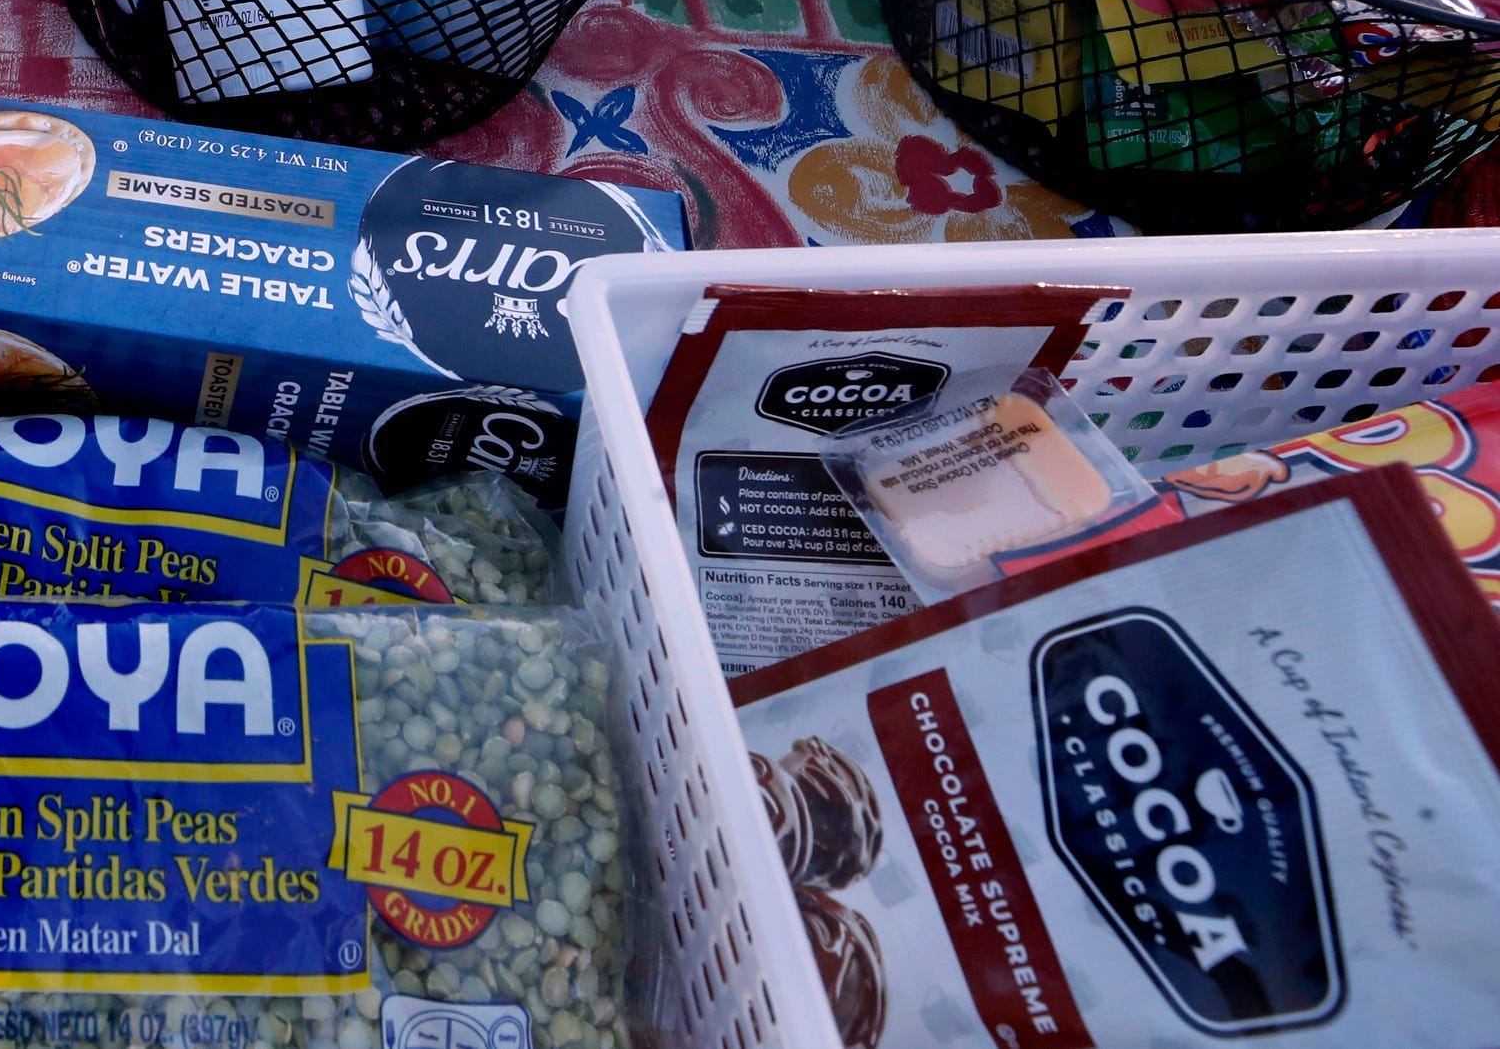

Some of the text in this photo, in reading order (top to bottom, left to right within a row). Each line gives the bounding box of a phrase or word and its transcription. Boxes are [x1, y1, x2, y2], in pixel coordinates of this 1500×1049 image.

[137, 129, 350, 174] NET 4.25 OZ (120g)
[116, 176, 325, 220] TOASTED SESAME
[424, 204, 605, 236] CARLISLE 1831 ENGLAND
[143, 224, 336, 272] CRACKERS
[1, 271, 37, 286] Serving
[219, 273, 336, 310] TABLE
[392, 231, 599, 318] arr's
[208, 358, 235, 419] TOASTED
[315, 371, 354, 426] TABLE
[784, 384, 913, 403] COCOA
[738, 466, 795, 482] Directions:
[738, 488, 809, 501] Place contents
[739, 504, 829, 516] HOT COCOA: Add
[742, 525, 832, 538] ICED COCOA: Add
[40, 521, 127, 578] Split
[135, 542, 219, 586] Peas
[743, 538, 823, 551] Pour over cup
[705, 571, 911, 592] Nutrition Facts Serving size Packet
[830, 595, 906, 609] Calories 140
[408, 779, 458, 818] NO.
[35, 791, 133, 853] Split
[143, 798, 238, 844] Peas
[1083, 672, 1248, 972] COCOA
[183, 856, 319, 905] Verdes
[361, 822, 508, 896] 14 OZ.
[910, 691, 1059, 1035] CHOCOLATE SUPREME
[923, 798, 983, 928] COCOA MIX
[37, 918, 138, 958] Matar
[146, 920, 202, 958] Dal
[379, 888, 481, 946] GRADE
